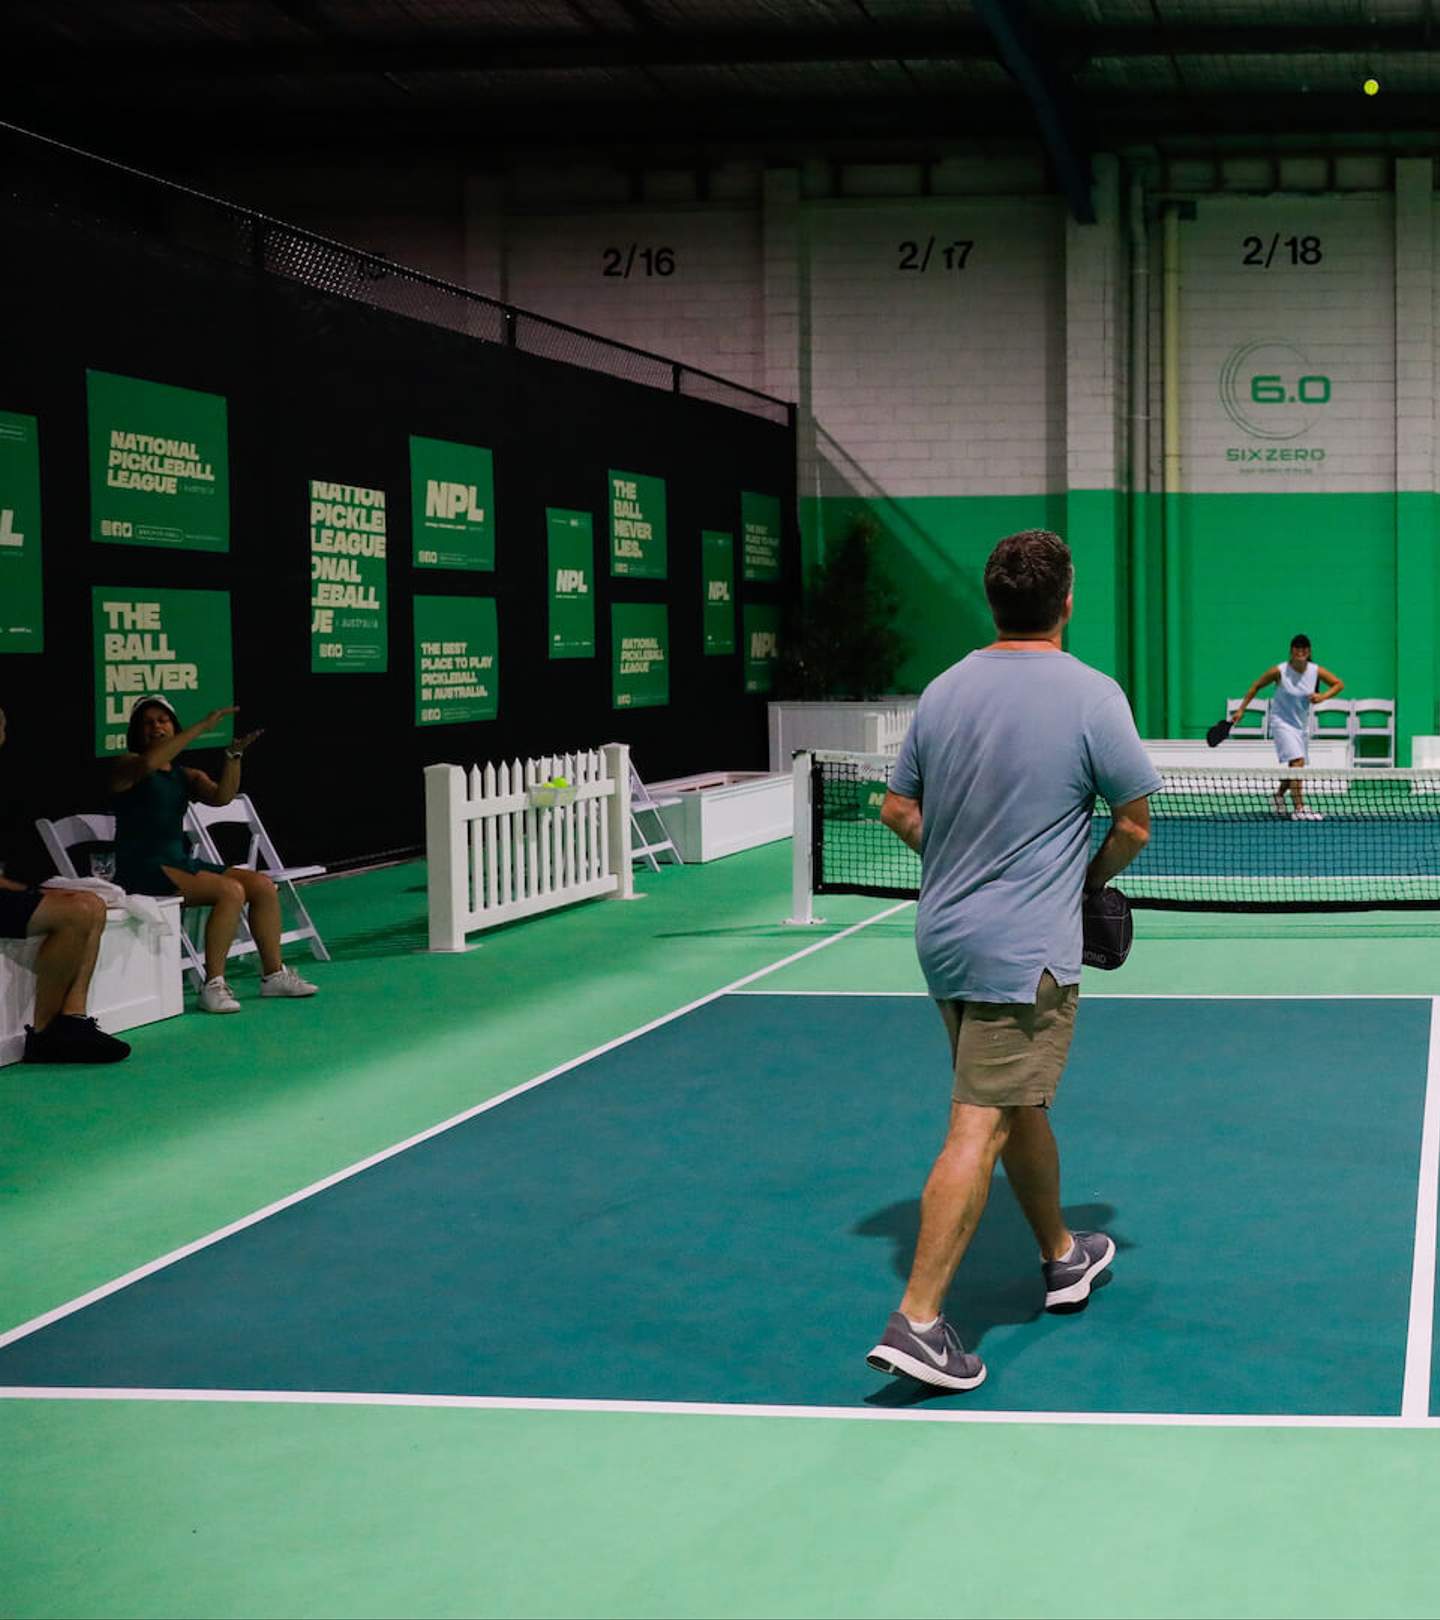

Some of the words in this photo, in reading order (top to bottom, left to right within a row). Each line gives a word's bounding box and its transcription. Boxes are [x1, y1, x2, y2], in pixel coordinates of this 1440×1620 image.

[602, 243, 675, 279] 2/16
[898, 236, 974, 273] 2/17
[1242, 231, 1323, 269] 2/18
[1251, 375, 1331, 404] 6.0
[110, 430, 200, 461] NATIONAL
[108, 449, 215, 481] PICKLEBALL
[107, 468, 178, 494] LEAGUE
[613, 479, 637, 501] THE
[425, 480, 484, 522] NPL
[613, 499, 643, 520] BALL
[311, 502, 386, 534] PICKLE
[614, 519, 653, 540] NEVER
[311, 528, 386, 559] LEAGUE
[556, 569, 588, 593] NPL
[708, 580, 730, 601] NPL
[103, 601, 161, 630] THE
[104, 633, 176, 661] BALL
[420, 642, 441, 655] THE
[442, 642, 467, 655] BEST
[751, 631, 778, 659] NPL
[105, 663, 198, 692] NEVER
[421, 658, 453, 671] PLACE
[454, 657, 467, 669] TO
[468, 656, 493, 669] PLAY
[620, 661, 650, 674] LEAGUE
[421, 672, 478, 685] PICKLEBALL
[421, 687, 433, 701] IN
